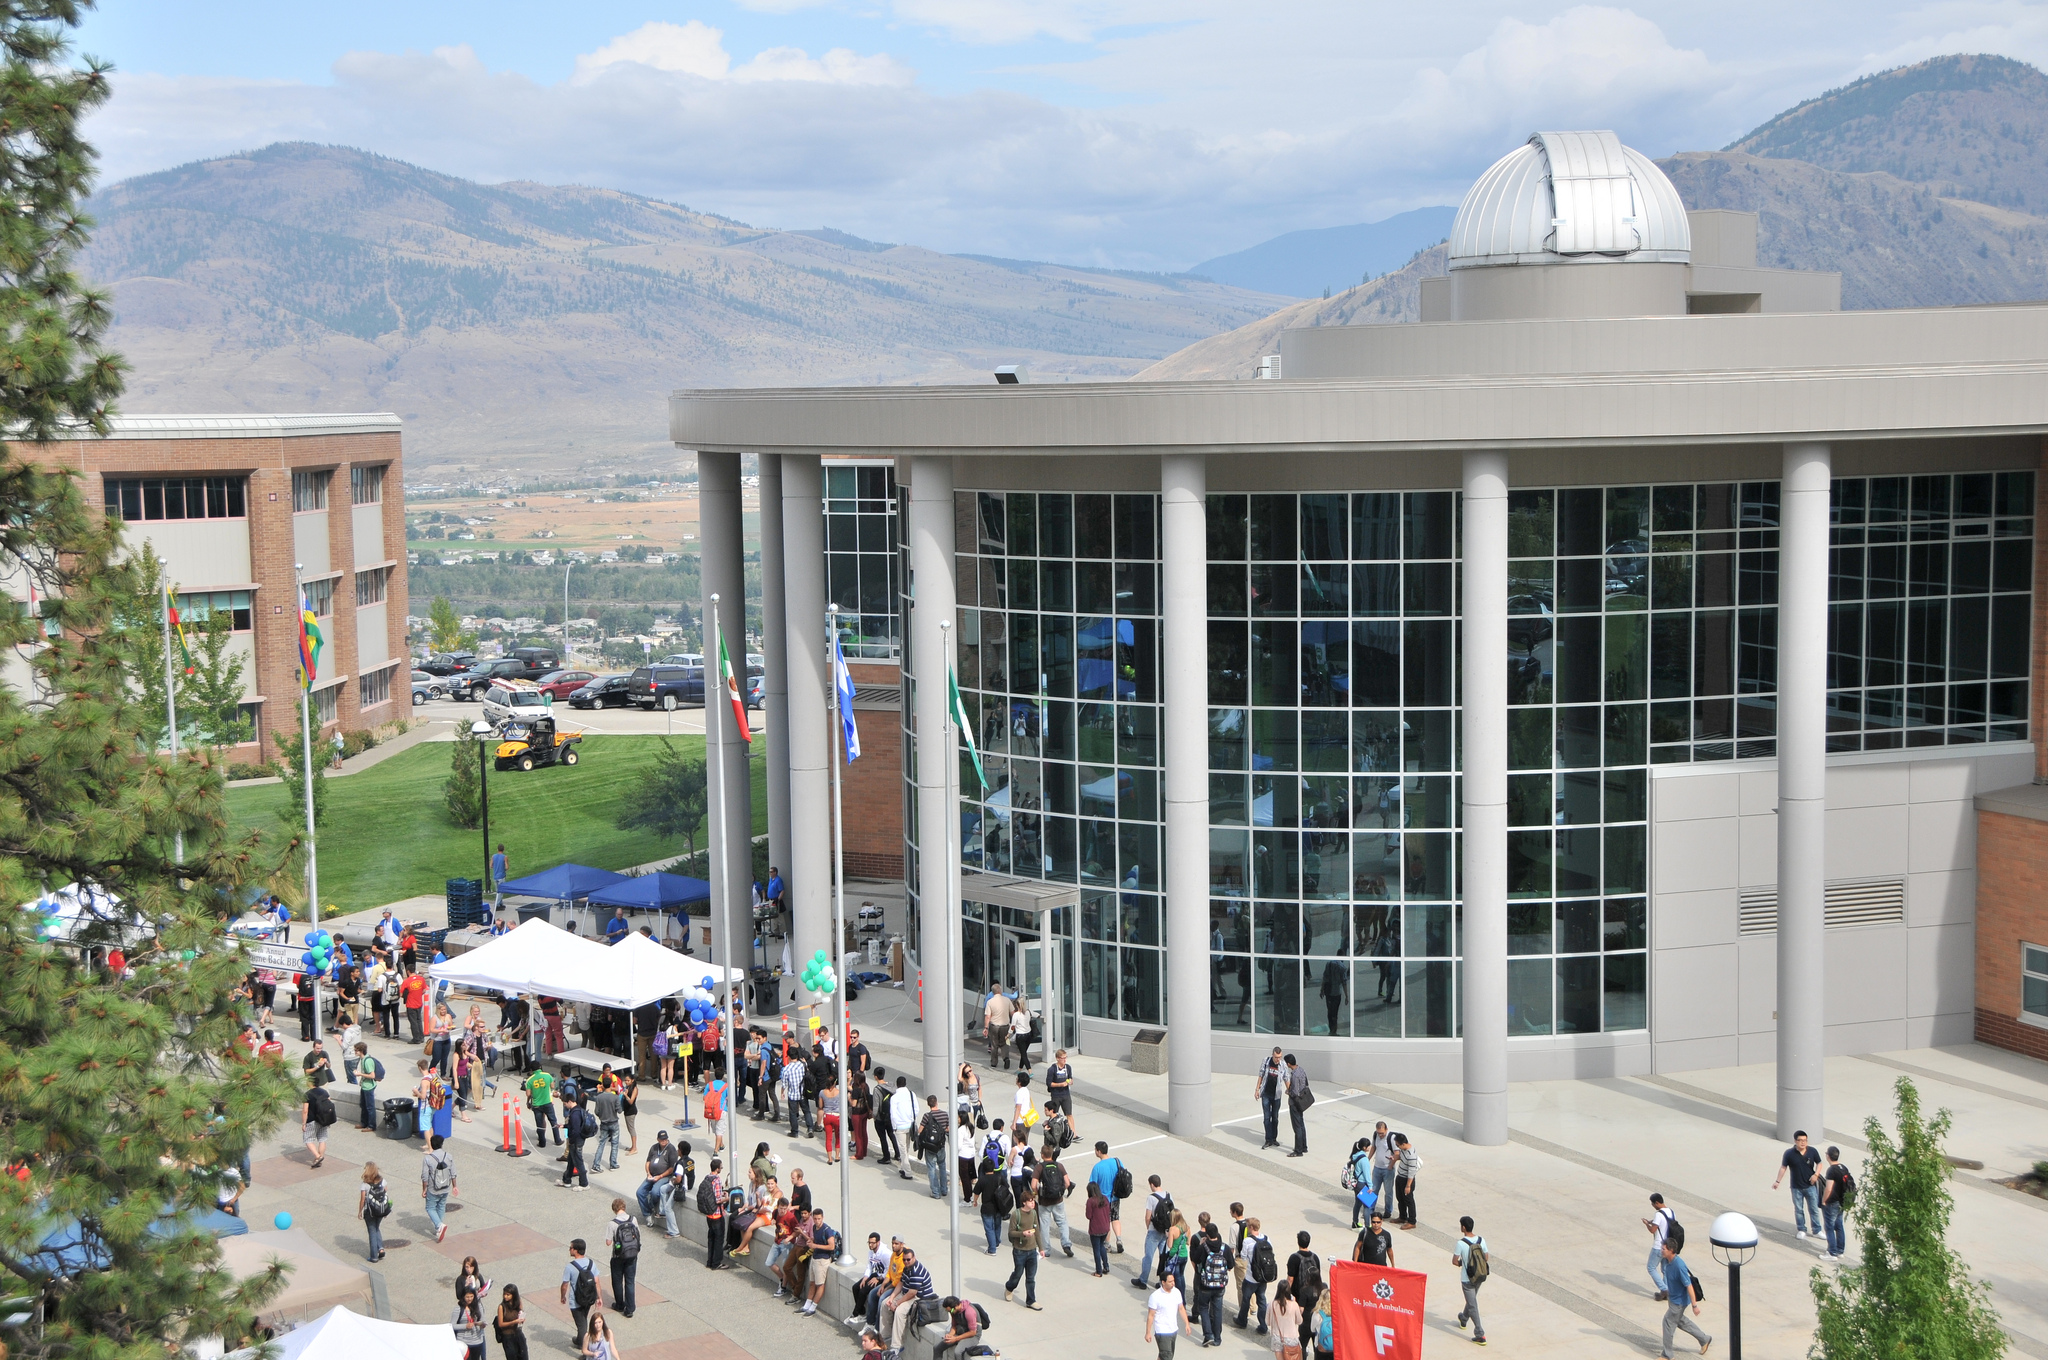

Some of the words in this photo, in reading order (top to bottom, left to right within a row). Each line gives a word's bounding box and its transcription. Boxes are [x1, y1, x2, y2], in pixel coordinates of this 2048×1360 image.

[266, 948, 286, 956] Annual
[268, 955, 285, 965] Back
[287, 958, 303, 969] BBQ
[1353, 1297, 1362, 1305] St.
[1363, 1300, 1377, 1308] John
[1379, 1302, 1415, 1315] Ambulance
[1374, 1325, 1394, 1355] F
